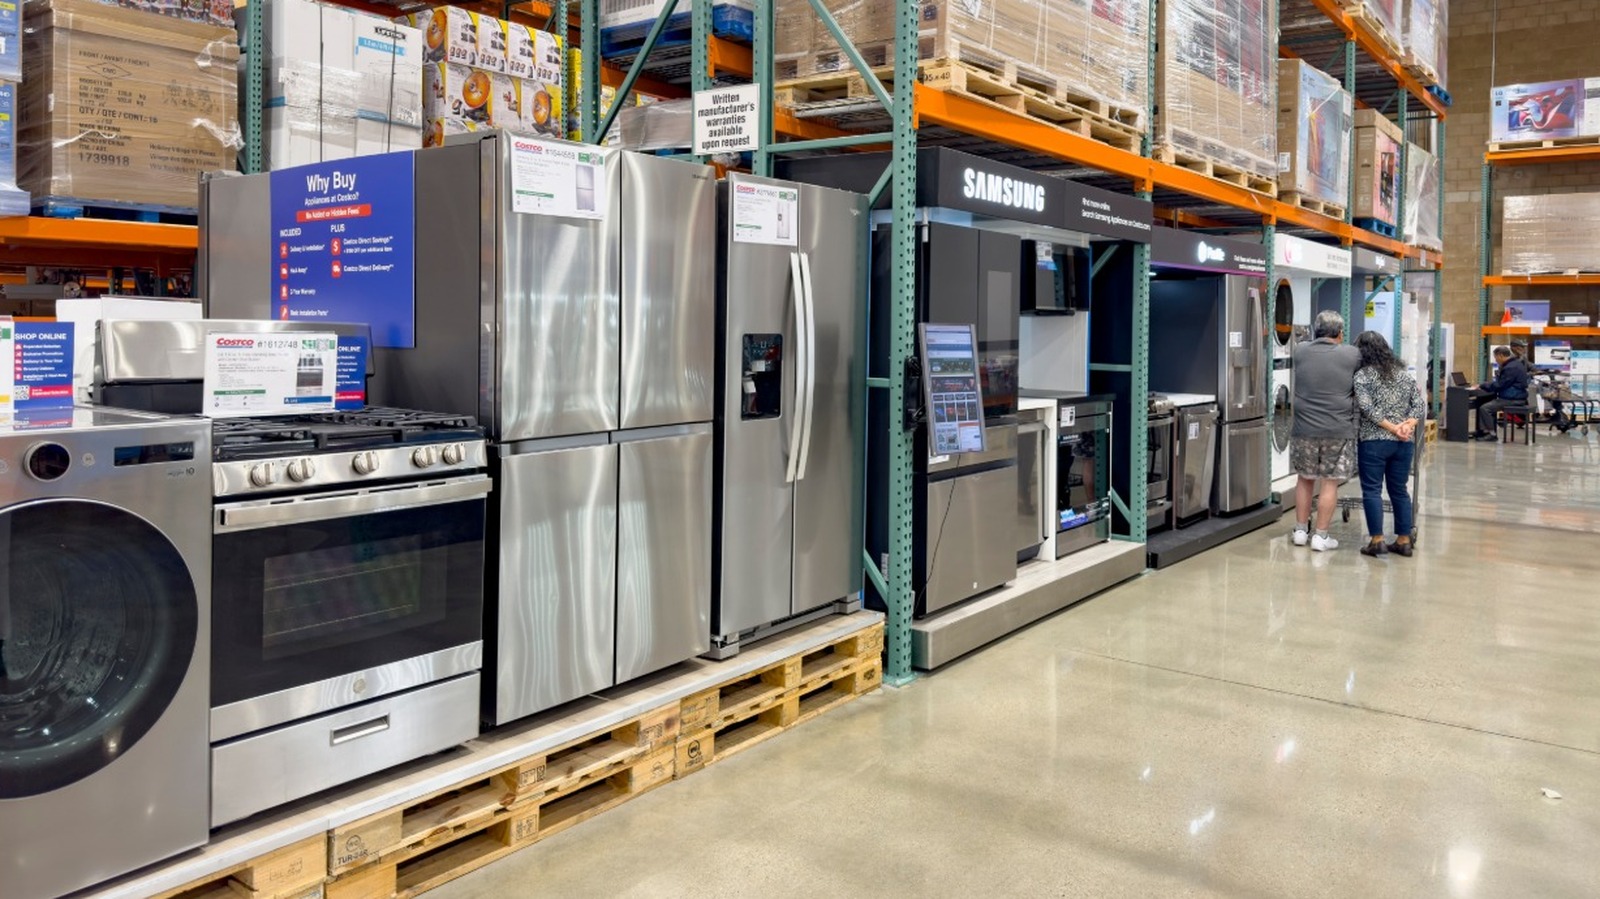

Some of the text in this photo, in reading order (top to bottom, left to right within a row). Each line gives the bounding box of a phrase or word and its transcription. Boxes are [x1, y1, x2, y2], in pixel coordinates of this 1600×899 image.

[712, 93, 740, 104] Written
[79, 106, 94, 115] QTY
[698, 101, 755, 117] manufacturer's
[706, 114, 746, 127] warranties
[708, 125, 743, 138] available
[702, 135, 750, 150] upon request
[79, 152, 130, 167] 1739918
[306, 171, 356, 194] Why Buy
[963, 167, 1046, 212] SAMSUNG
[304, 191, 359, 206] Appliances at Costco?
[331, 208, 347, 216] Hidden
[280, 227, 302, 237] INCLUDED
[330, 223, 345, 233] PLUS
[15, 333, 67, 341] SHOP ONLINE
[216, 337, 254, 347] COSTCO
